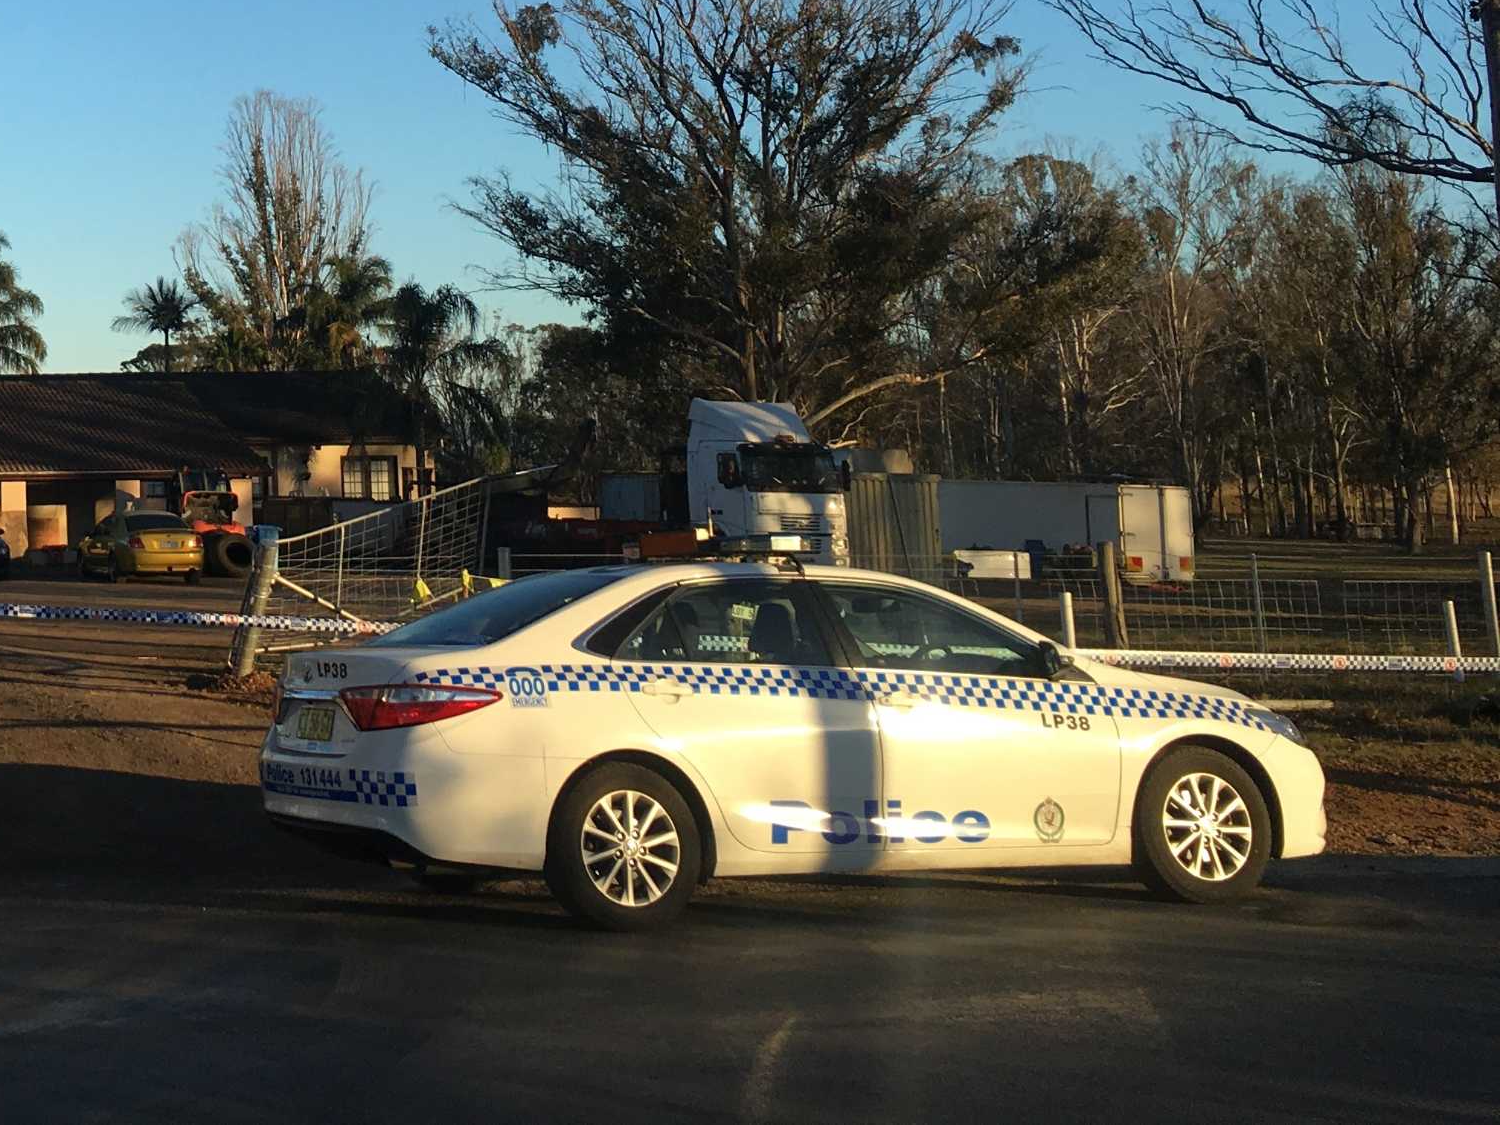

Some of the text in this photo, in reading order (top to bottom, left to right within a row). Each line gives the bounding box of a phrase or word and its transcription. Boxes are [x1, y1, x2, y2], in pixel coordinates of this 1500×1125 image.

[316, 661, 348, 679] LP38
[508, 676, 546, 696] 000
[1040, 712, 1091, 732] LP38
